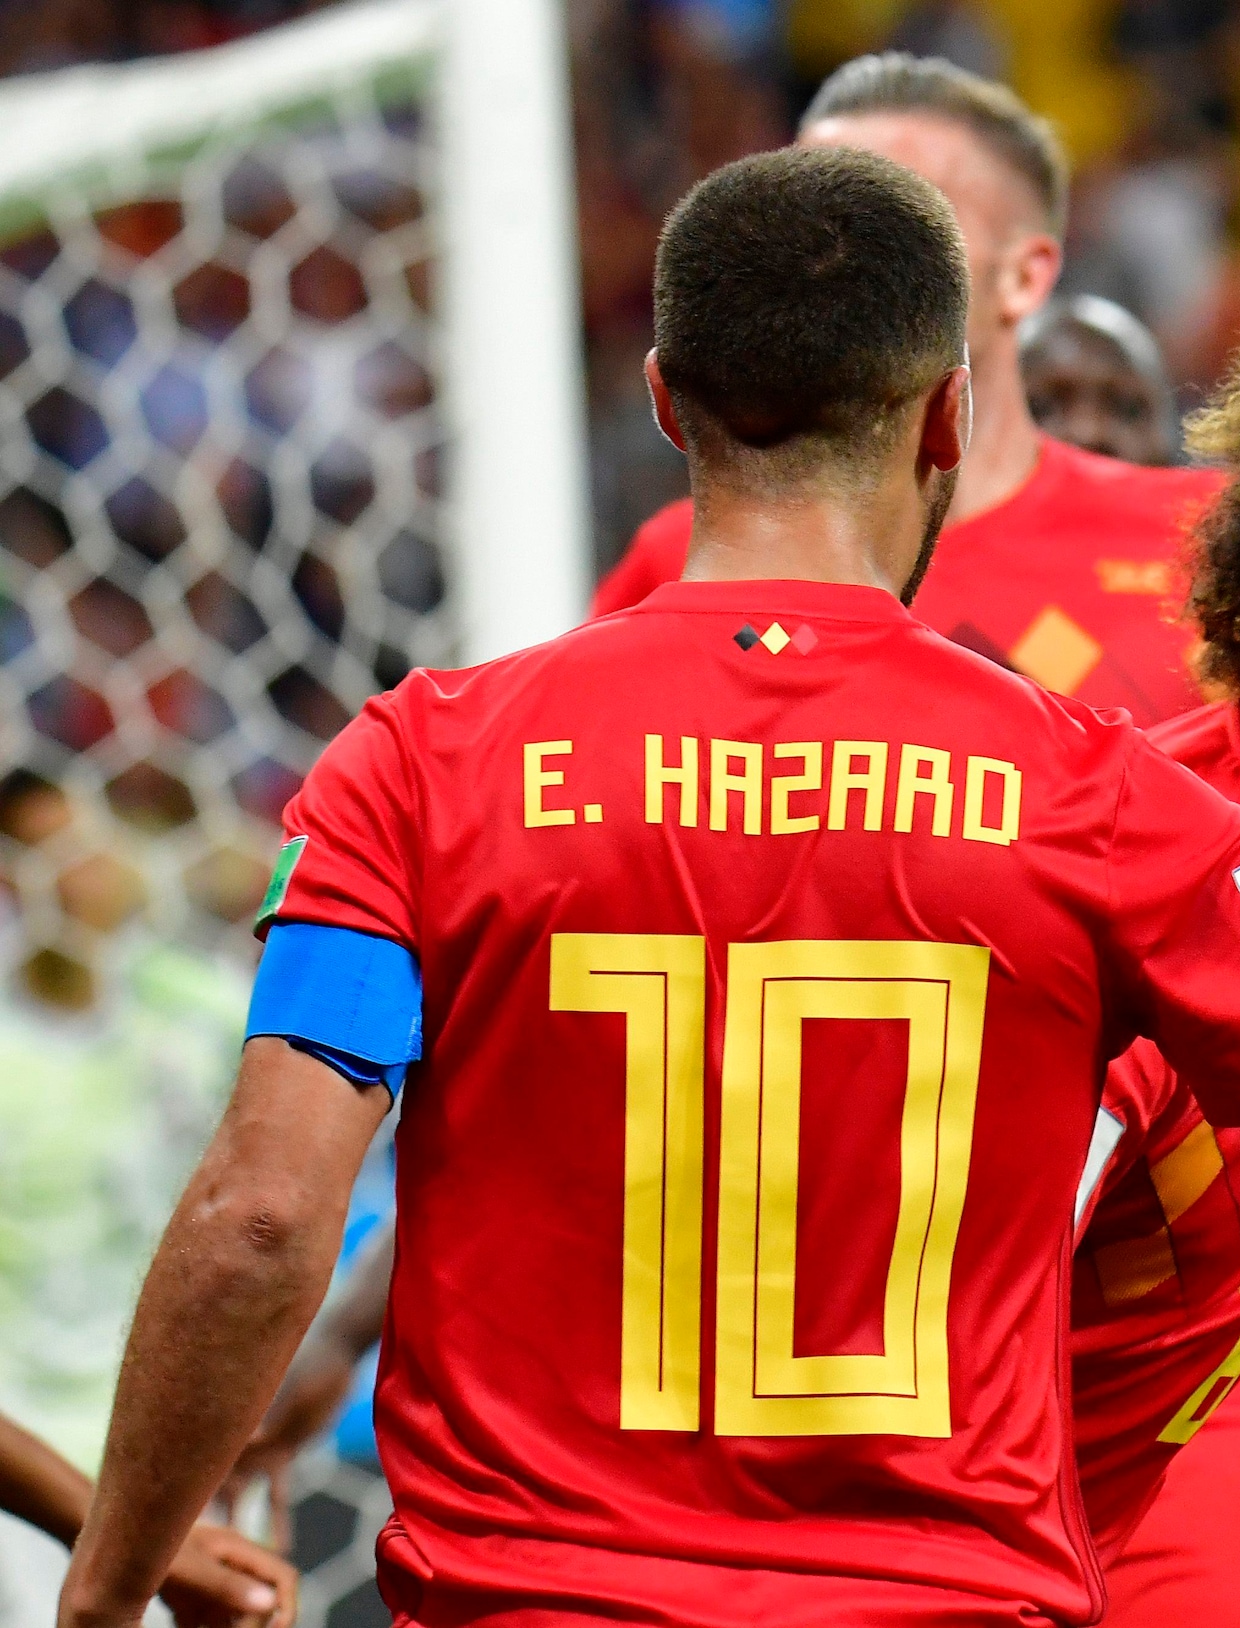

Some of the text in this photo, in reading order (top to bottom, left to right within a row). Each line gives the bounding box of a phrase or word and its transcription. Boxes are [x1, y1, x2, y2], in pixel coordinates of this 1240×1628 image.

[523, 733, 1022, 846] E. HAZARD
[549, 933, 991, 1438] 10
